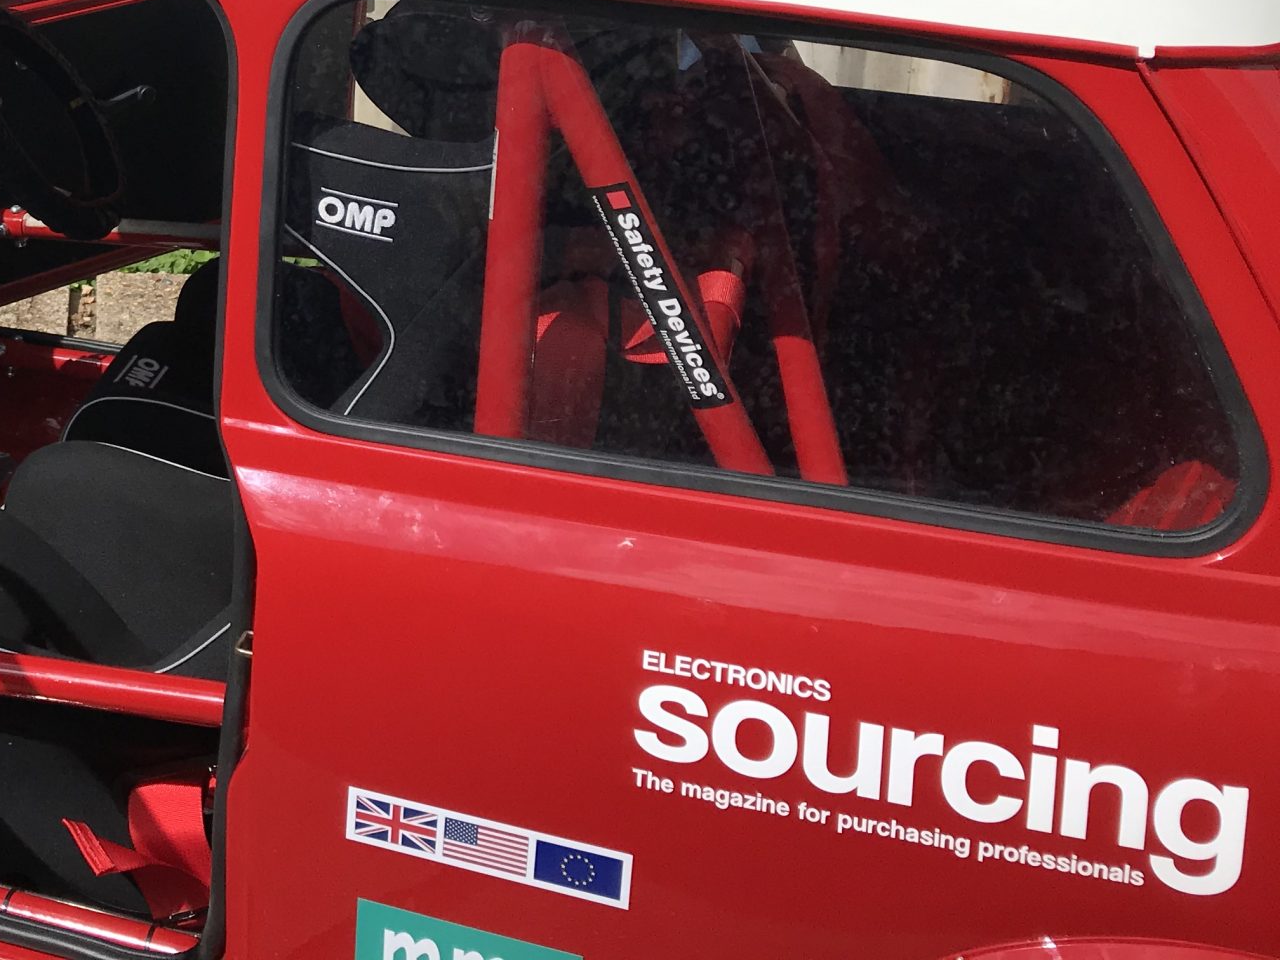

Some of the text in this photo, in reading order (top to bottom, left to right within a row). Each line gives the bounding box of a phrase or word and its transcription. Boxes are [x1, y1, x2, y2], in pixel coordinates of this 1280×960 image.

[317, 195, 397, 235] OMP
[616, 212, 668, 292] Safety
[592, 194, 658, 326] www.safetydevices.com
[659, 329, 701, 401] International Ltd
[641, 648, 832, 702] ELECTRONICS
[631, 766, 1146, 887] The magazine for purchasing professionals
[632, 683, 1250, 897] sourcing
